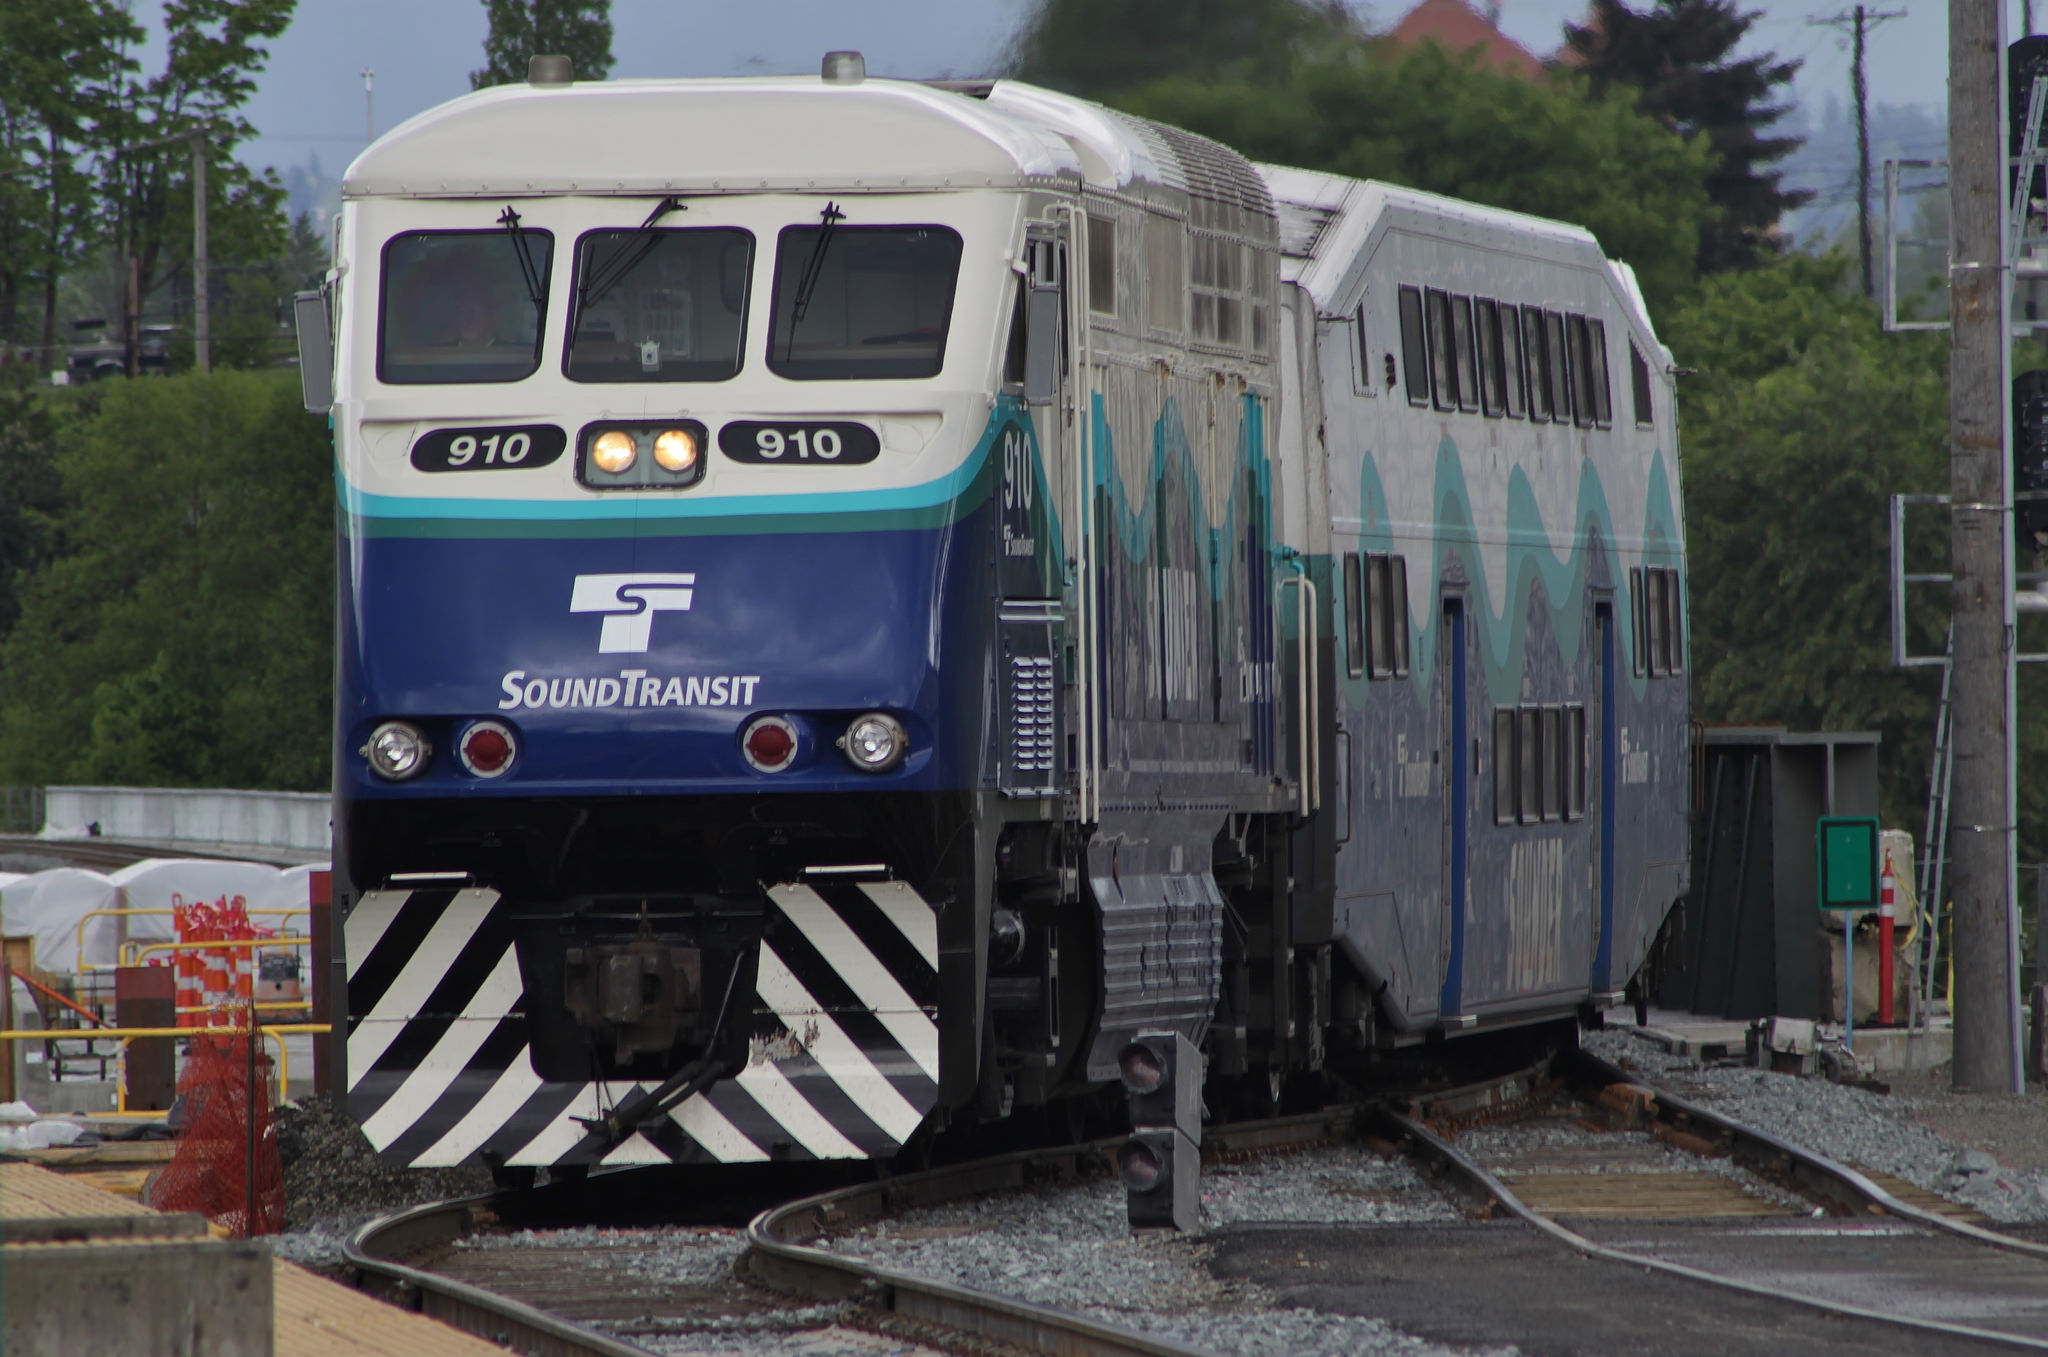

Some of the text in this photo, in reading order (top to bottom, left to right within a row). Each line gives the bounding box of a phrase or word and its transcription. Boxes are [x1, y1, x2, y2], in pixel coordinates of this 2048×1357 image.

[447, 433, 532, 466] 910
[756, 429, 842, 460] 910
[1004, 429, 1033, 511] 910
